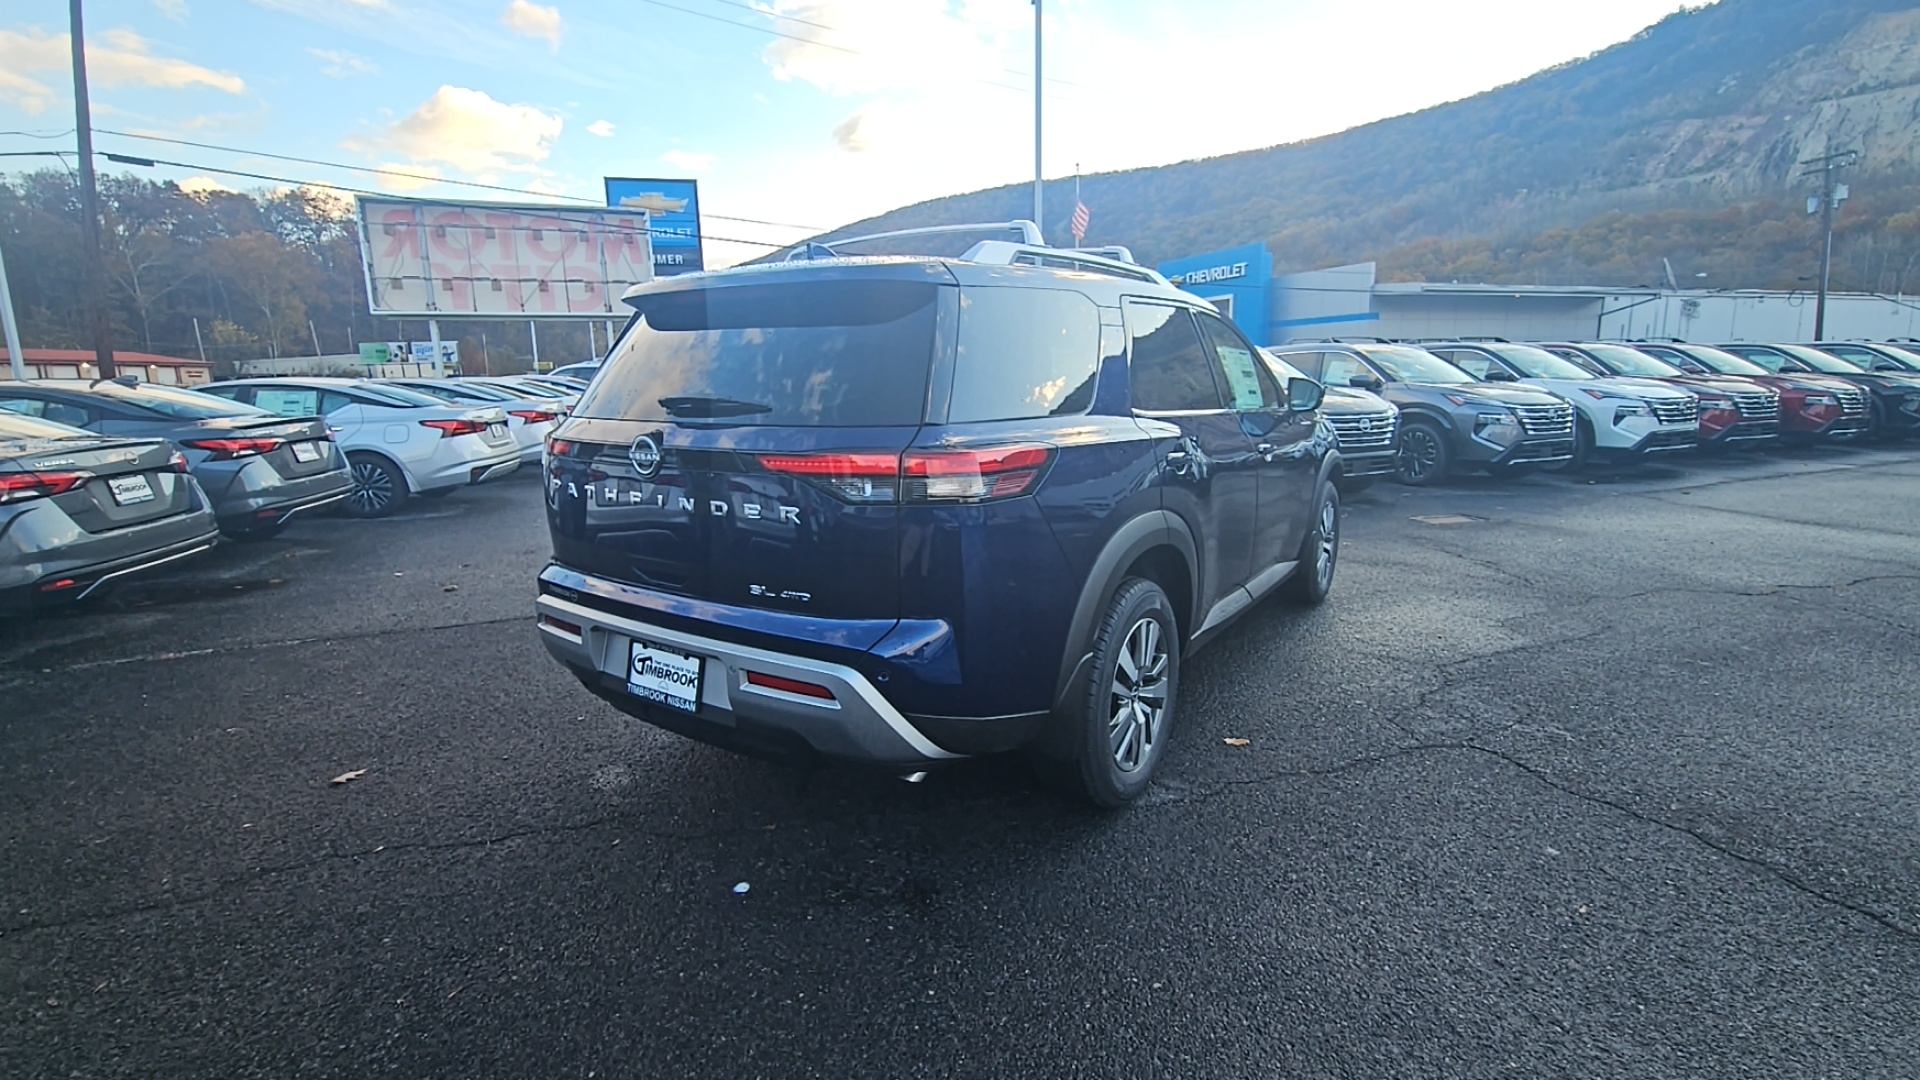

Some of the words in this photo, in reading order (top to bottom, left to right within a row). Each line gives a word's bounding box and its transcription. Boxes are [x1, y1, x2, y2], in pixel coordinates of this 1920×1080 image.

[1186, 262, 1248, 284] CHEVROLET
[34, 458, 76, 468] VERSA
[629, 452, 660, 461] NISSAN
[551, 478, 801, 524] PATHFINDER
[632, 653, 698, 689] TIMBROOK
[627, 683, 666, 704] TIMBROOK
[667, 695, 697, 713] NISSAN
